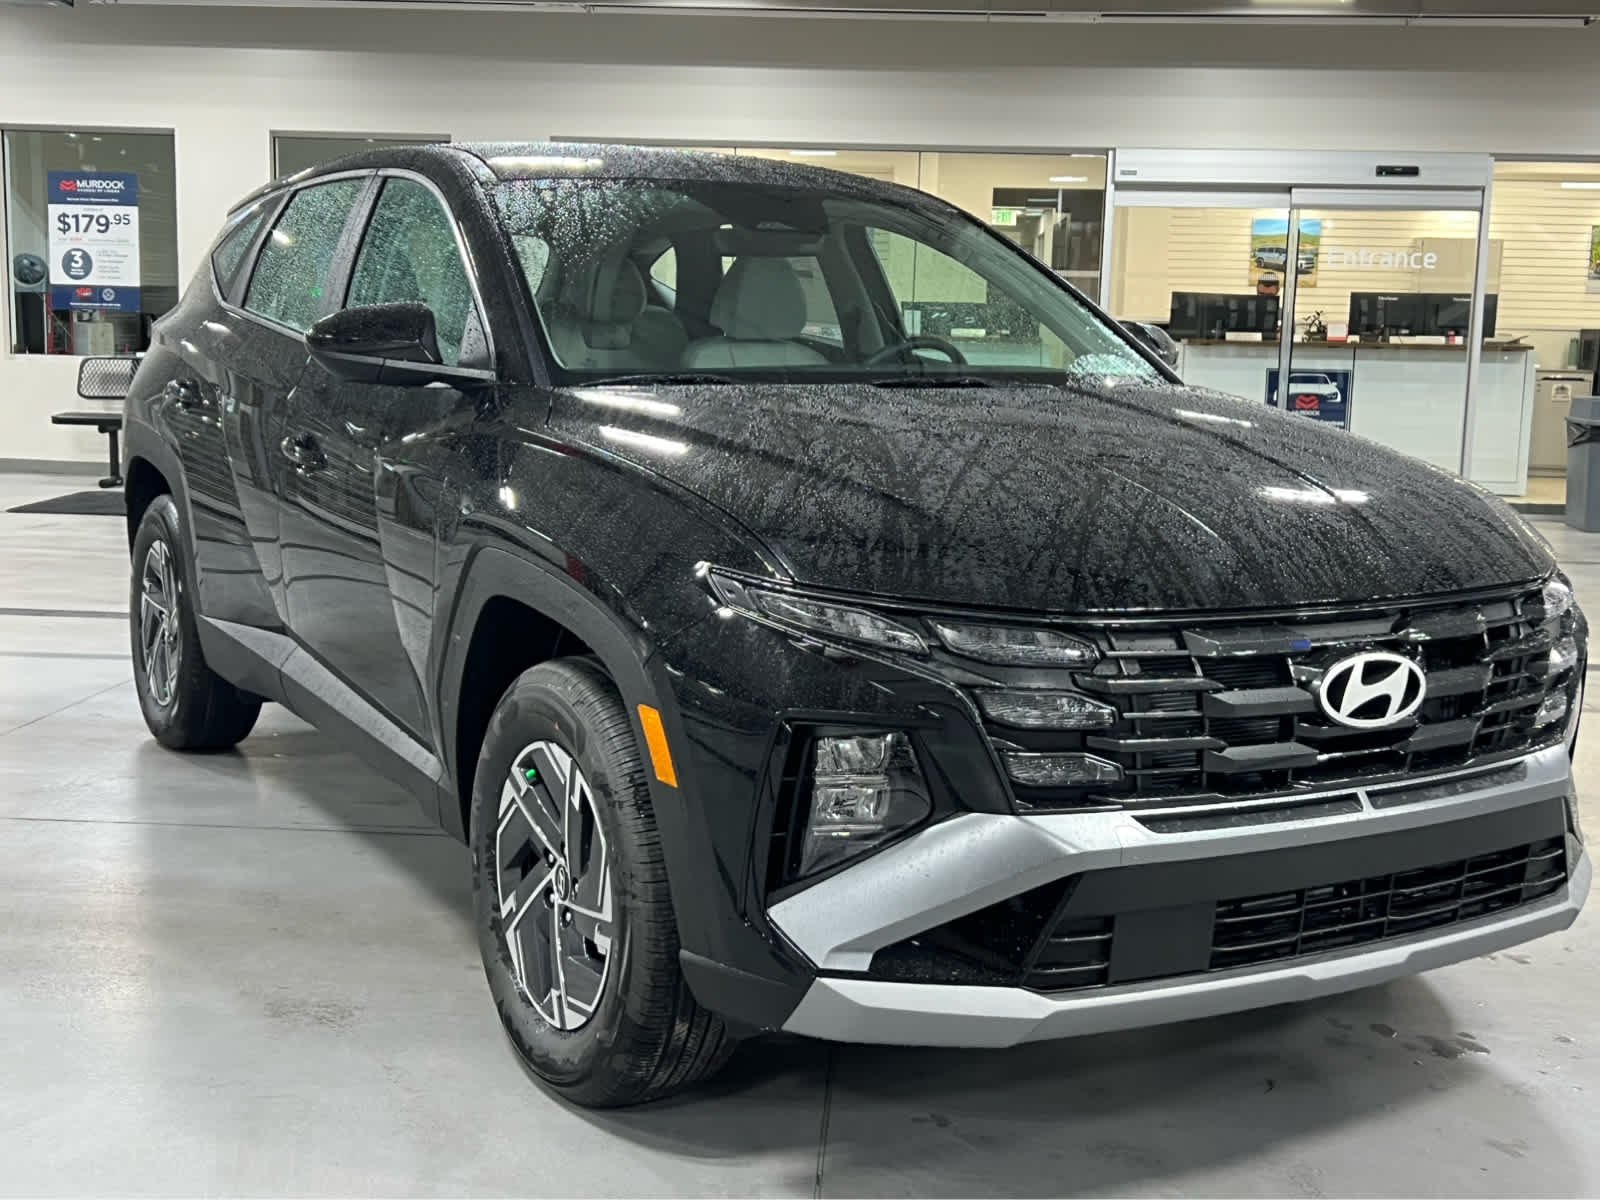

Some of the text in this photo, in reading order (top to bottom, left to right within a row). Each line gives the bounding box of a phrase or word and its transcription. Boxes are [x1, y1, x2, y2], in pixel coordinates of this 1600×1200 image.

[76, 180, 125, 190] MURDOCK
[70, 251, 83, 267] 3
[1328, 248, 1438, 269] Entrance
